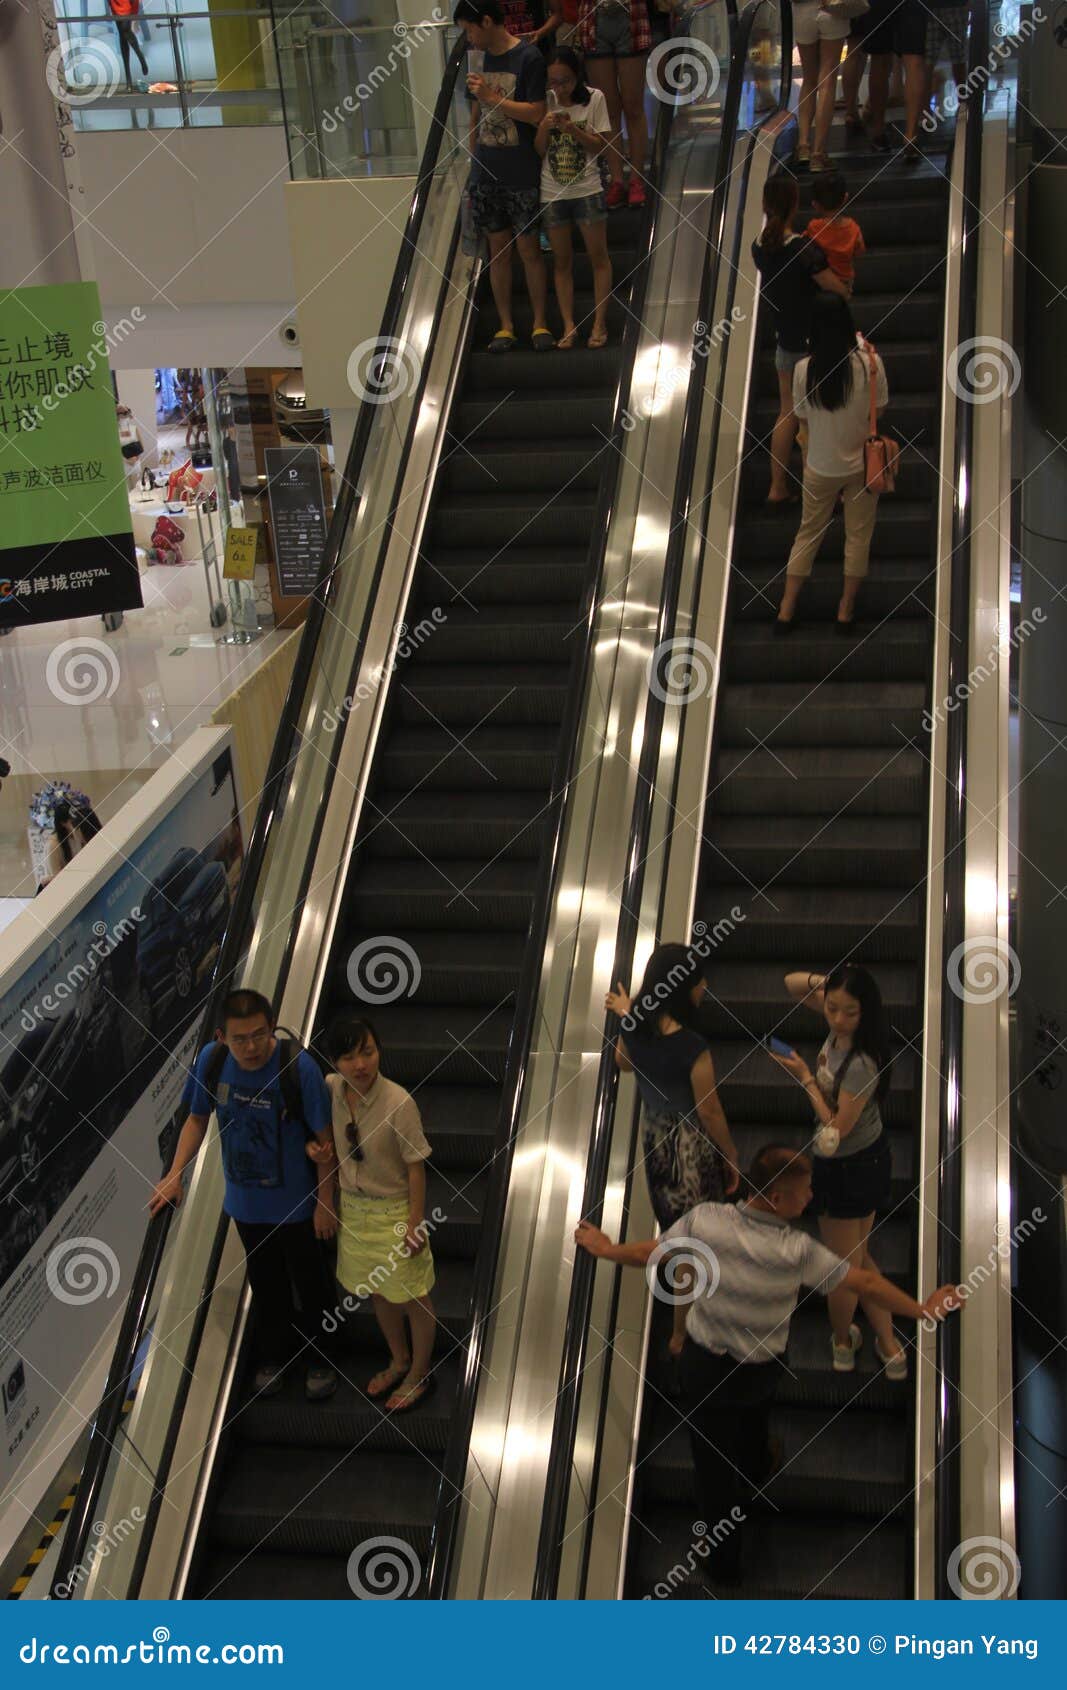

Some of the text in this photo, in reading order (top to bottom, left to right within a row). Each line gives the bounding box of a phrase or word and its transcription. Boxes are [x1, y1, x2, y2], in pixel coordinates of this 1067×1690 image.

[0, 364, 95, 400] 你肌肤
[0, 460, 105, 490] 声波洁面仪
[230, 534, 254, 546] SALE
[14, 567, 111, 597] 海岸城 COASTAL
[70, 579, 94, 590] CITY
